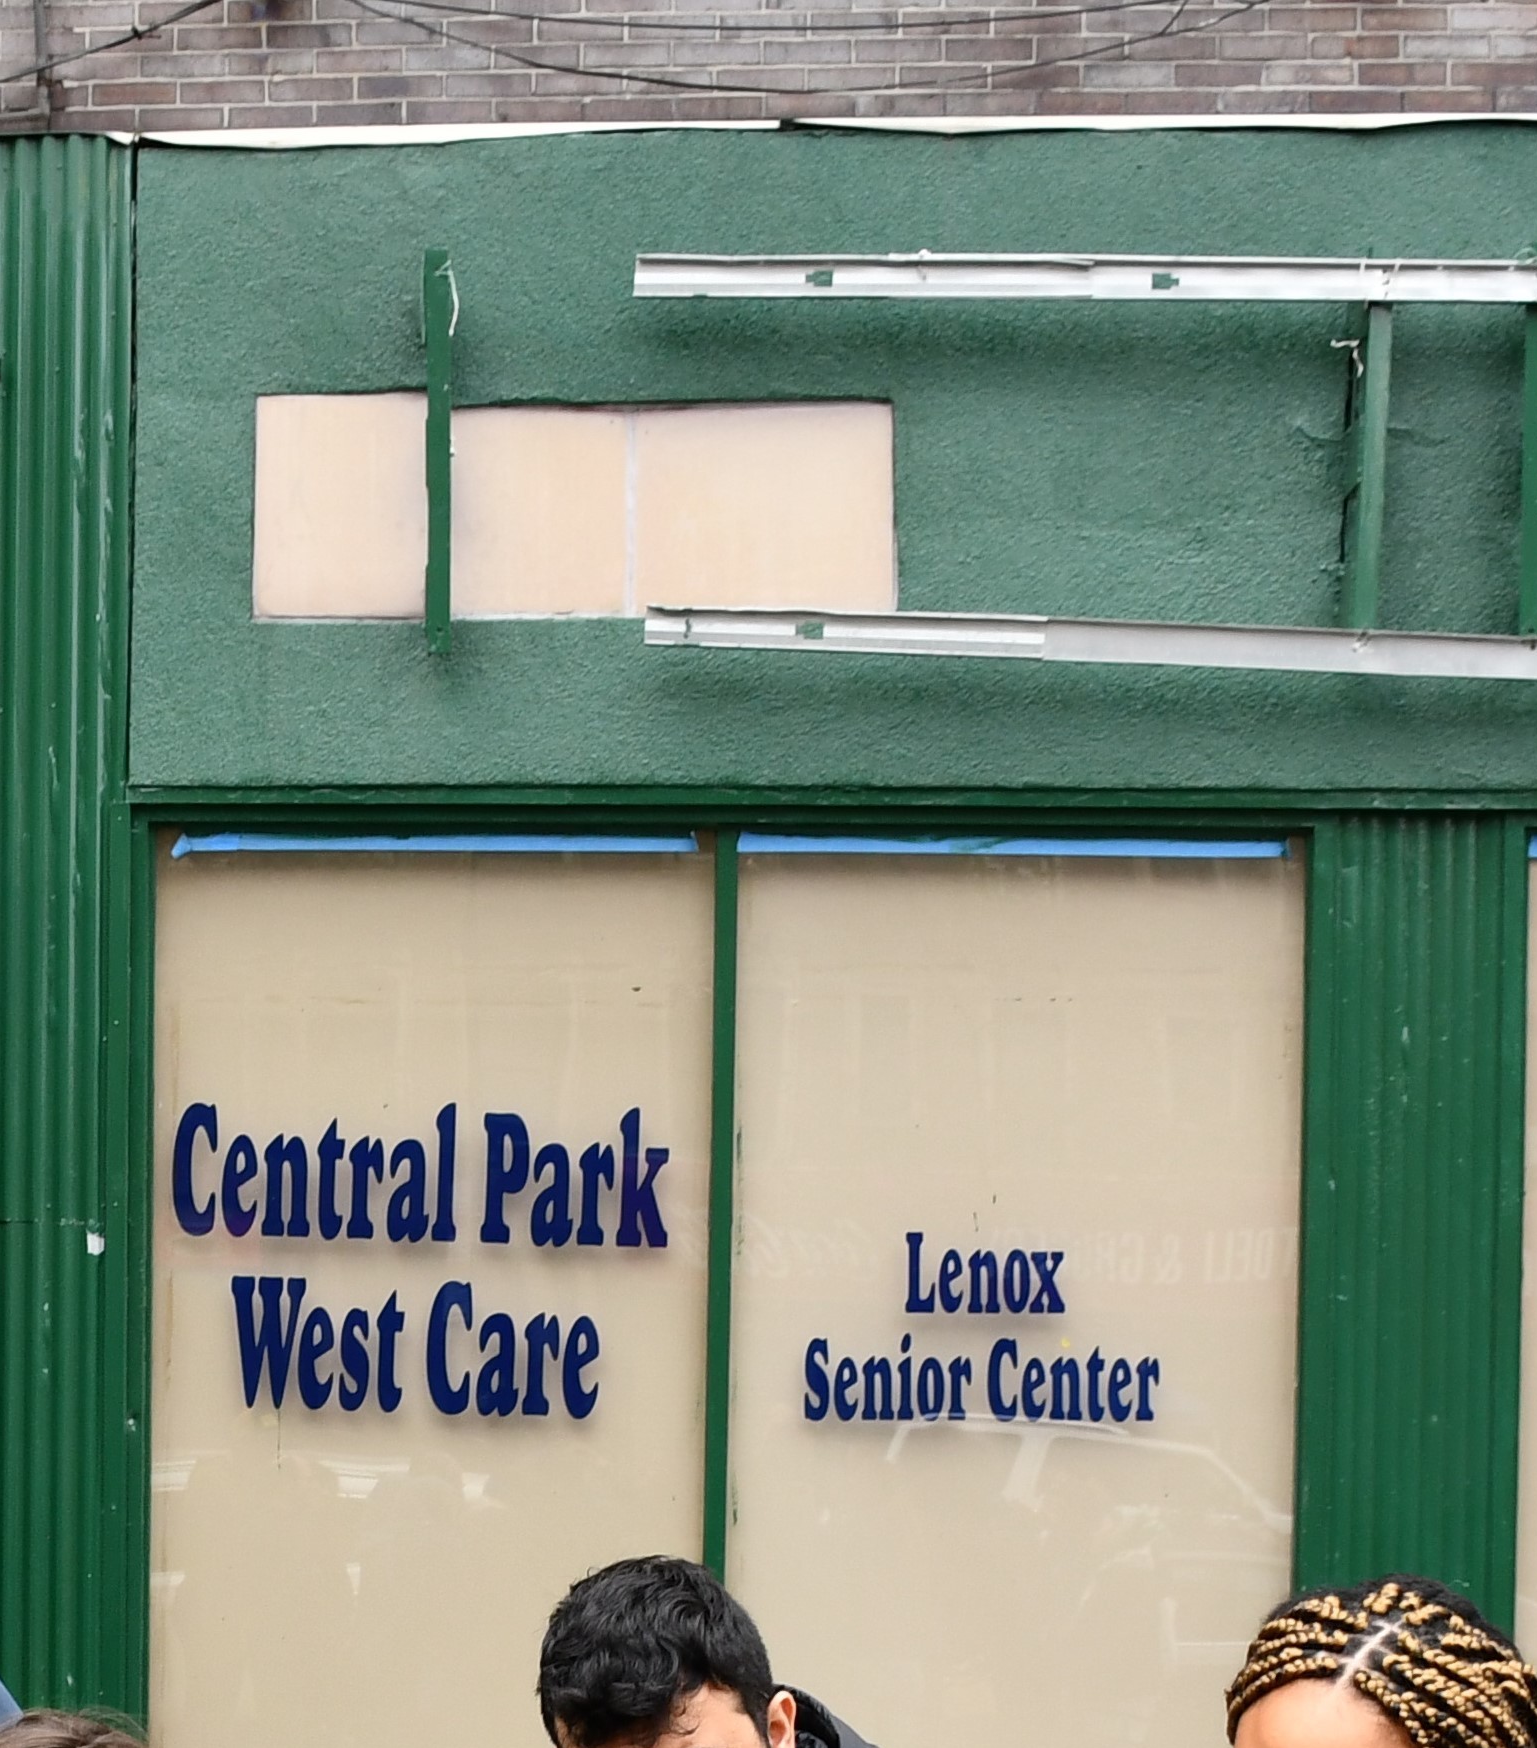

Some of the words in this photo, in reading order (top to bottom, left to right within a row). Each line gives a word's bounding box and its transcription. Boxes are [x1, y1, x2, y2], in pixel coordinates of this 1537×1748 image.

[172, 1101, 457, 1244] Central
[478, 1106, 670, 1248] Park
[904, 1231, 1066, 1314] Lenox
[230, 1275, 406, 1414] West
[425, 1280, 600, 1420] Care
[804, 1332, 972, 1422] Senior
[987, 1337, 1160, 1423] Center
